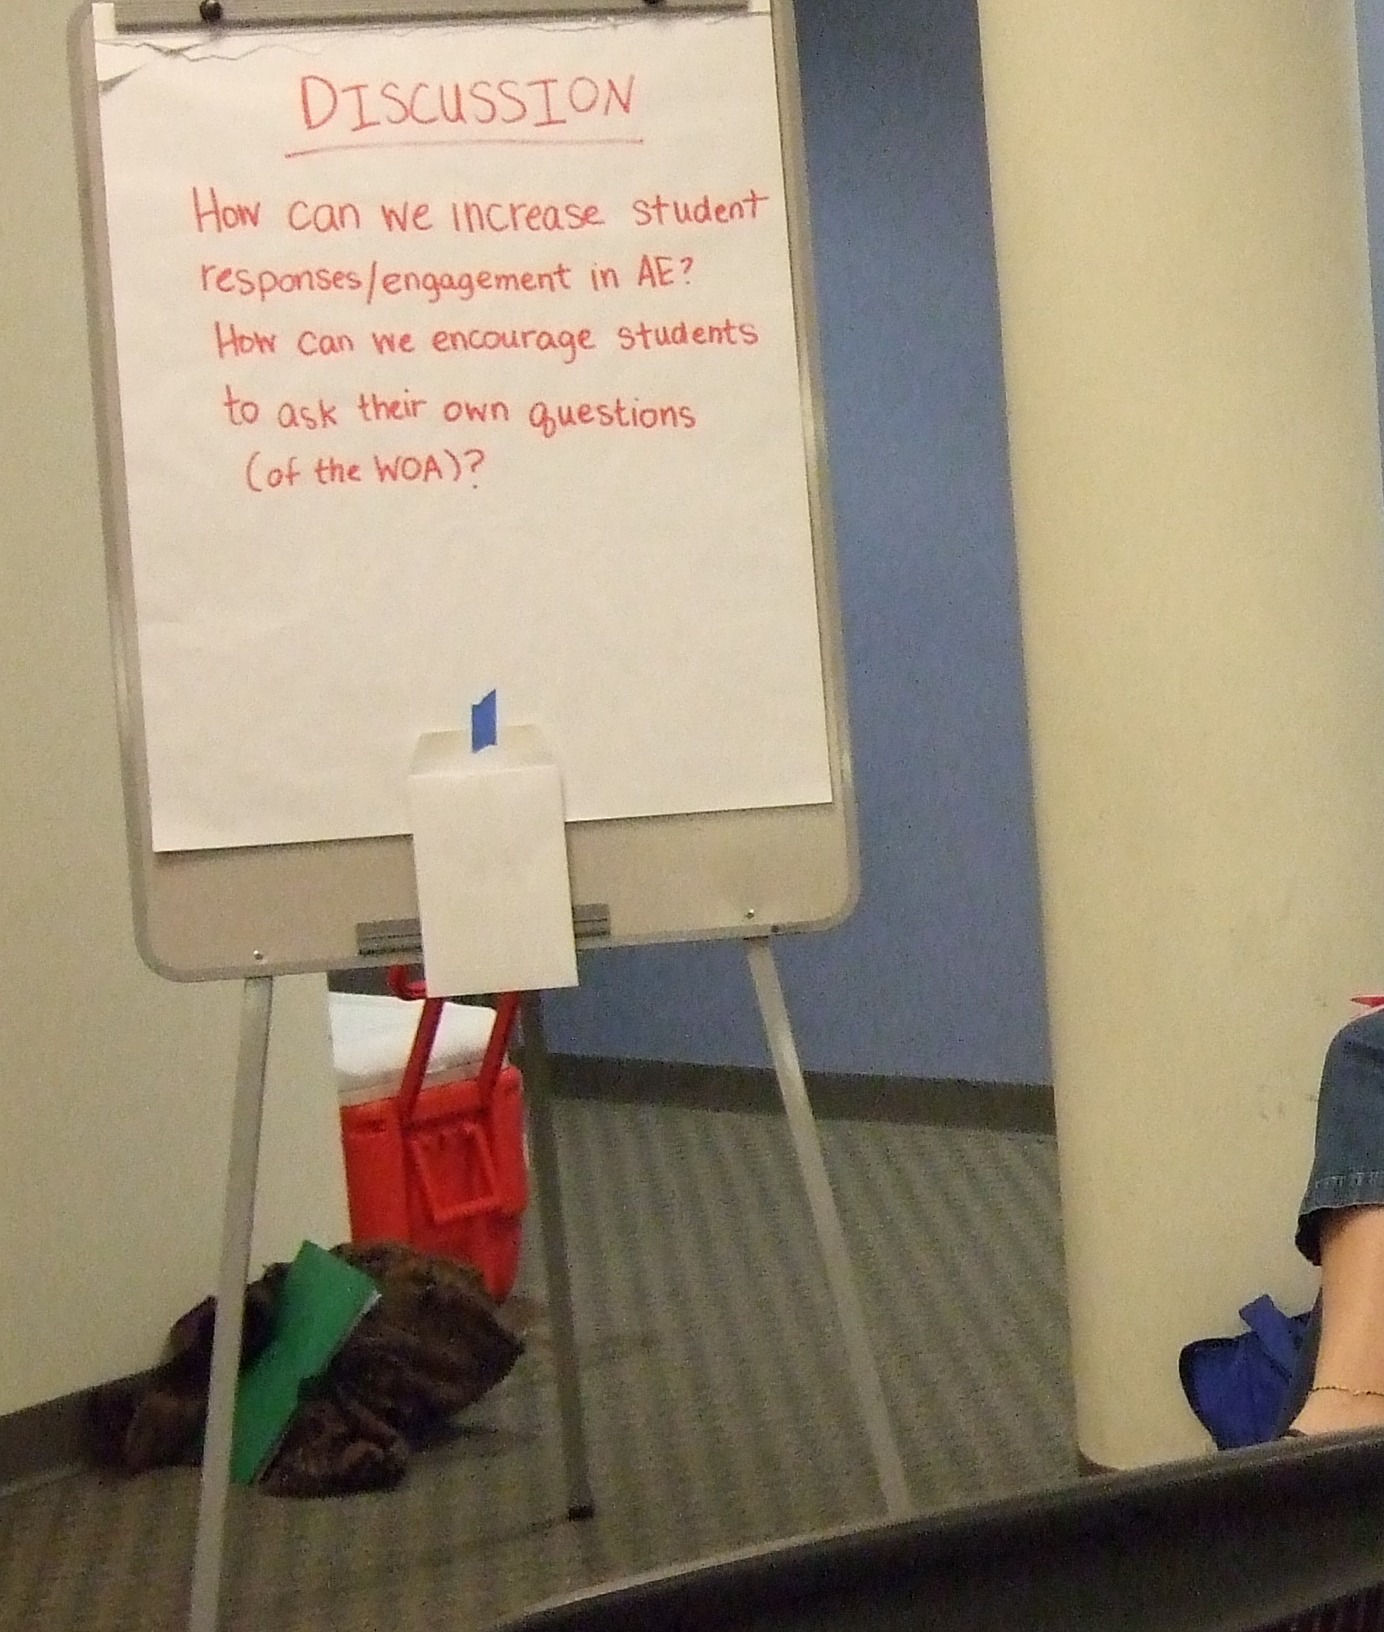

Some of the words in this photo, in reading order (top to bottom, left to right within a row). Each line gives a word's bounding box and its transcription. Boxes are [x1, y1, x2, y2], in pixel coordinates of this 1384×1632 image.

[301, 75, 634, 132] DISCUSSION
[192, 187, 262, 232] How
[287, 200, 363, 233] can
[381, 203, 431, 233] we
[452, 202, 604, 233] increase
[634, 189, 769, 227] student
[200, 261, 571, 302] responses/engagement
[592, 261, 621, 290] in
[638, 255, 696, 288] AE?
[214, 321, 279, 358] How
[297, 331, 355, 358] can
[372, 332, 414, 355] we
[431, 328, 595, 364] encourage
[618, 320, 761, 351] students
[224, 385, 260, 425] to
[277, 401, 338, 430] ask
[358, 388, 426, 422] their
[443, 400, 511, 424] own
[529, 397, 699, 439] questions
[246, 450, 300, 493] (of
[314, 459, 362, 485] the
[376, 448, 487, 490] WOA)?
